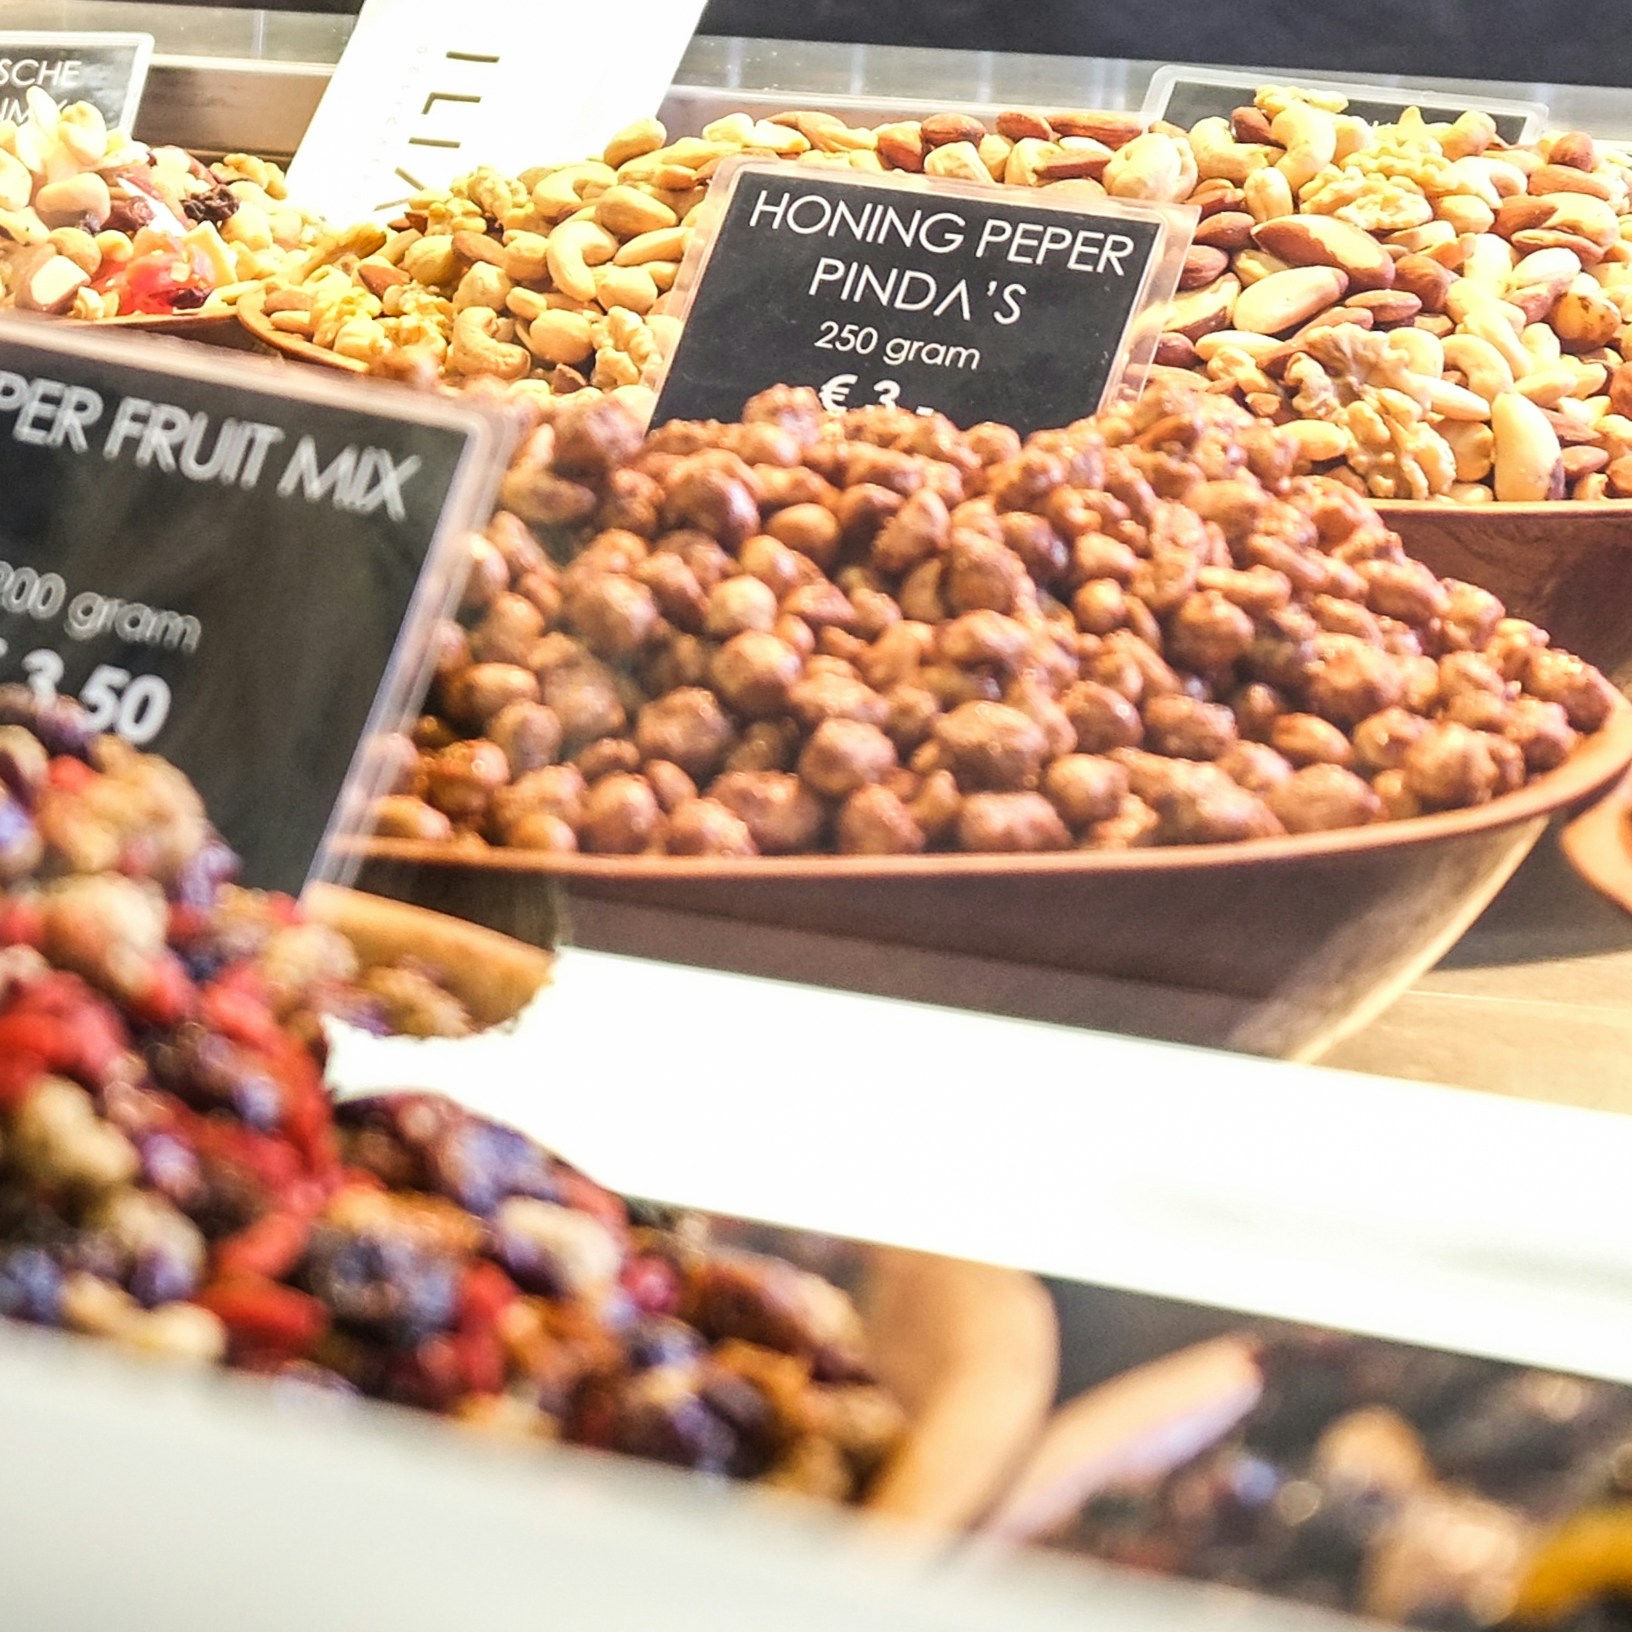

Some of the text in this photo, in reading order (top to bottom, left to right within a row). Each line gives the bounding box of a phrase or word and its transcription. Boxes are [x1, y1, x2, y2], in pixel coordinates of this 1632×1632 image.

[748, 189, 1135, 277] HONING PEPER
[813, 320, 982, 371] 250 gram
[817, 373, 859, 413] €
[102, 396, 286, 490] FRUIT
[277, 434, 424, 523] MIX
[63, 591, 202, 654] gram
